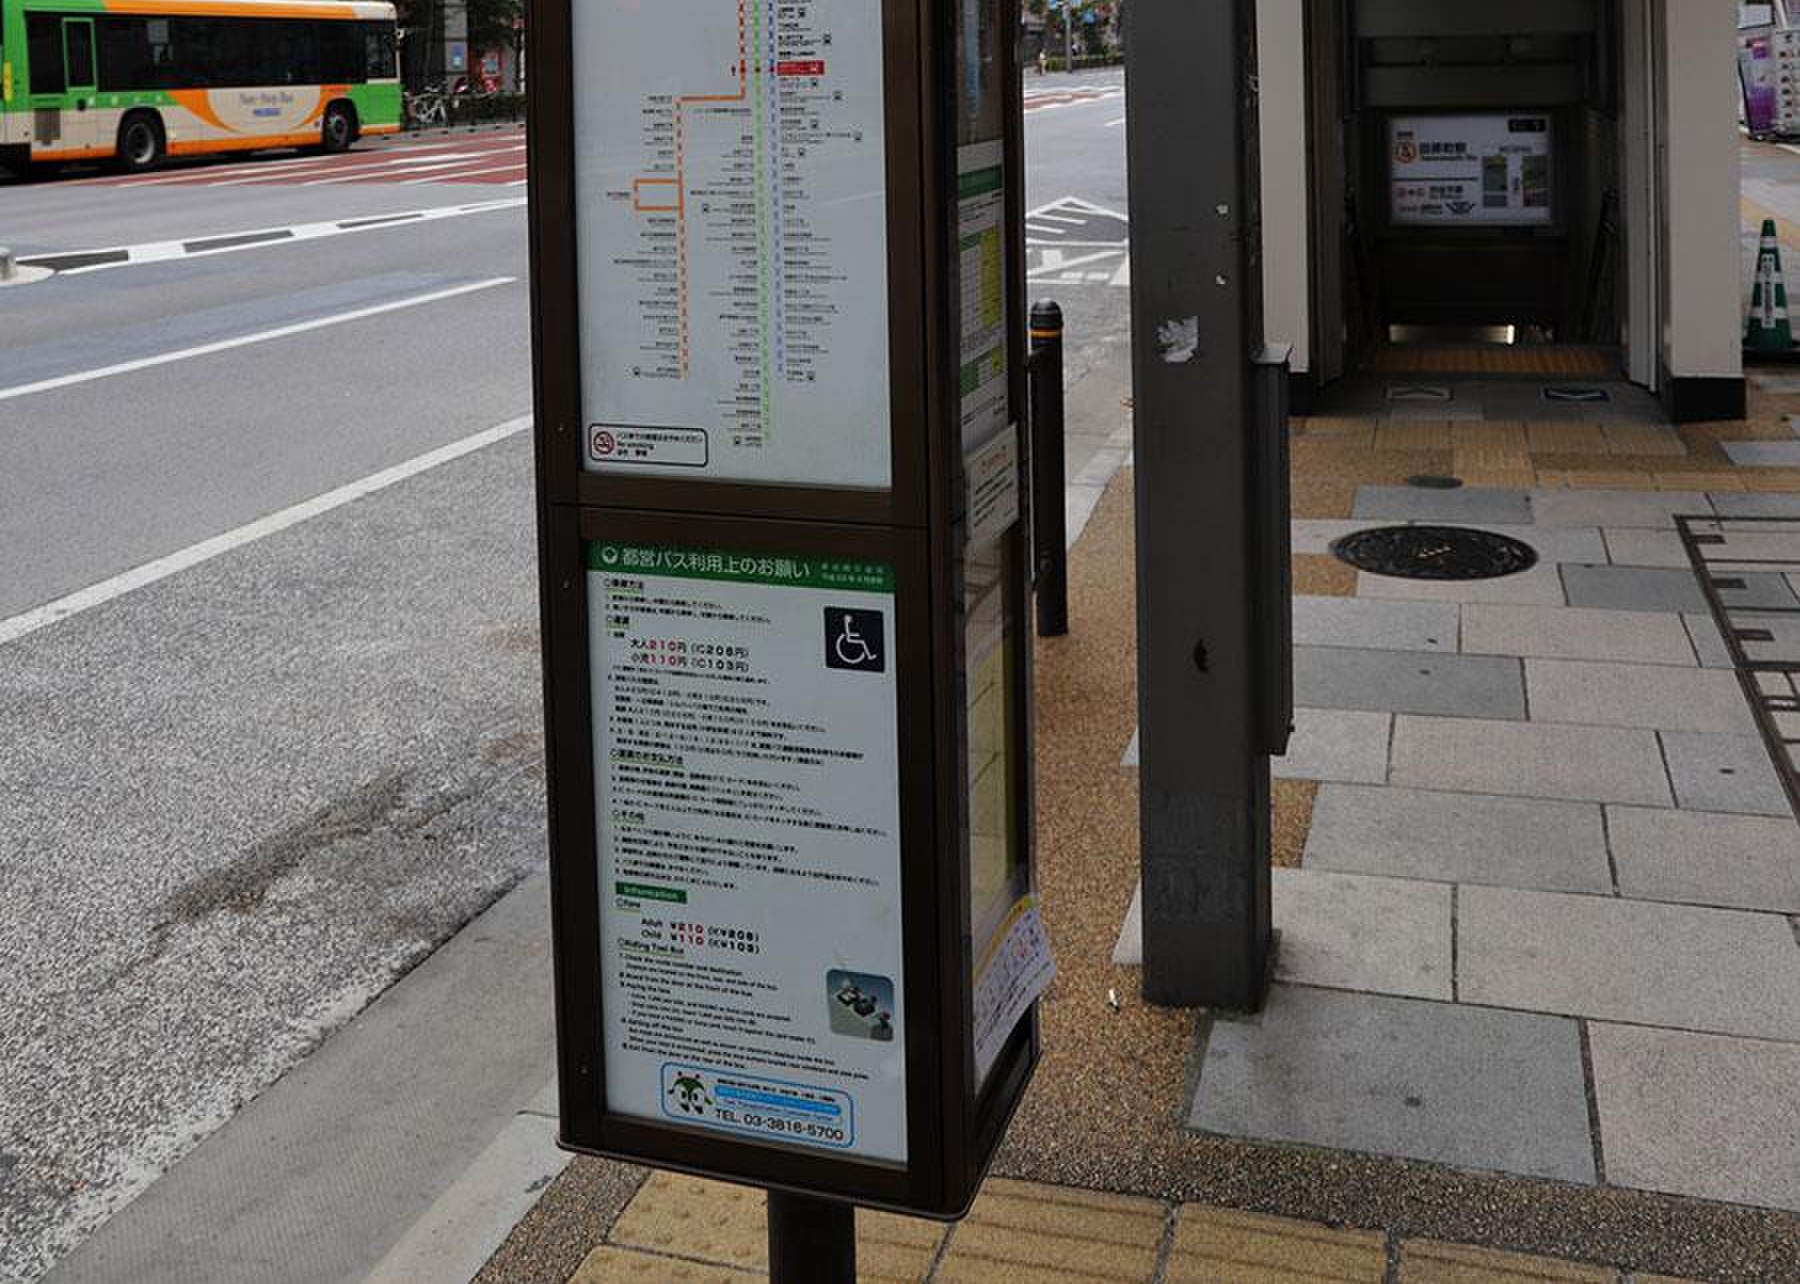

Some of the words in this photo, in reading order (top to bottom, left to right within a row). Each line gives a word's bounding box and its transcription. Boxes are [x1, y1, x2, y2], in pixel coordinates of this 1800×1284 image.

[622, 546, 811, 579] 都営バス利用上のお願い
